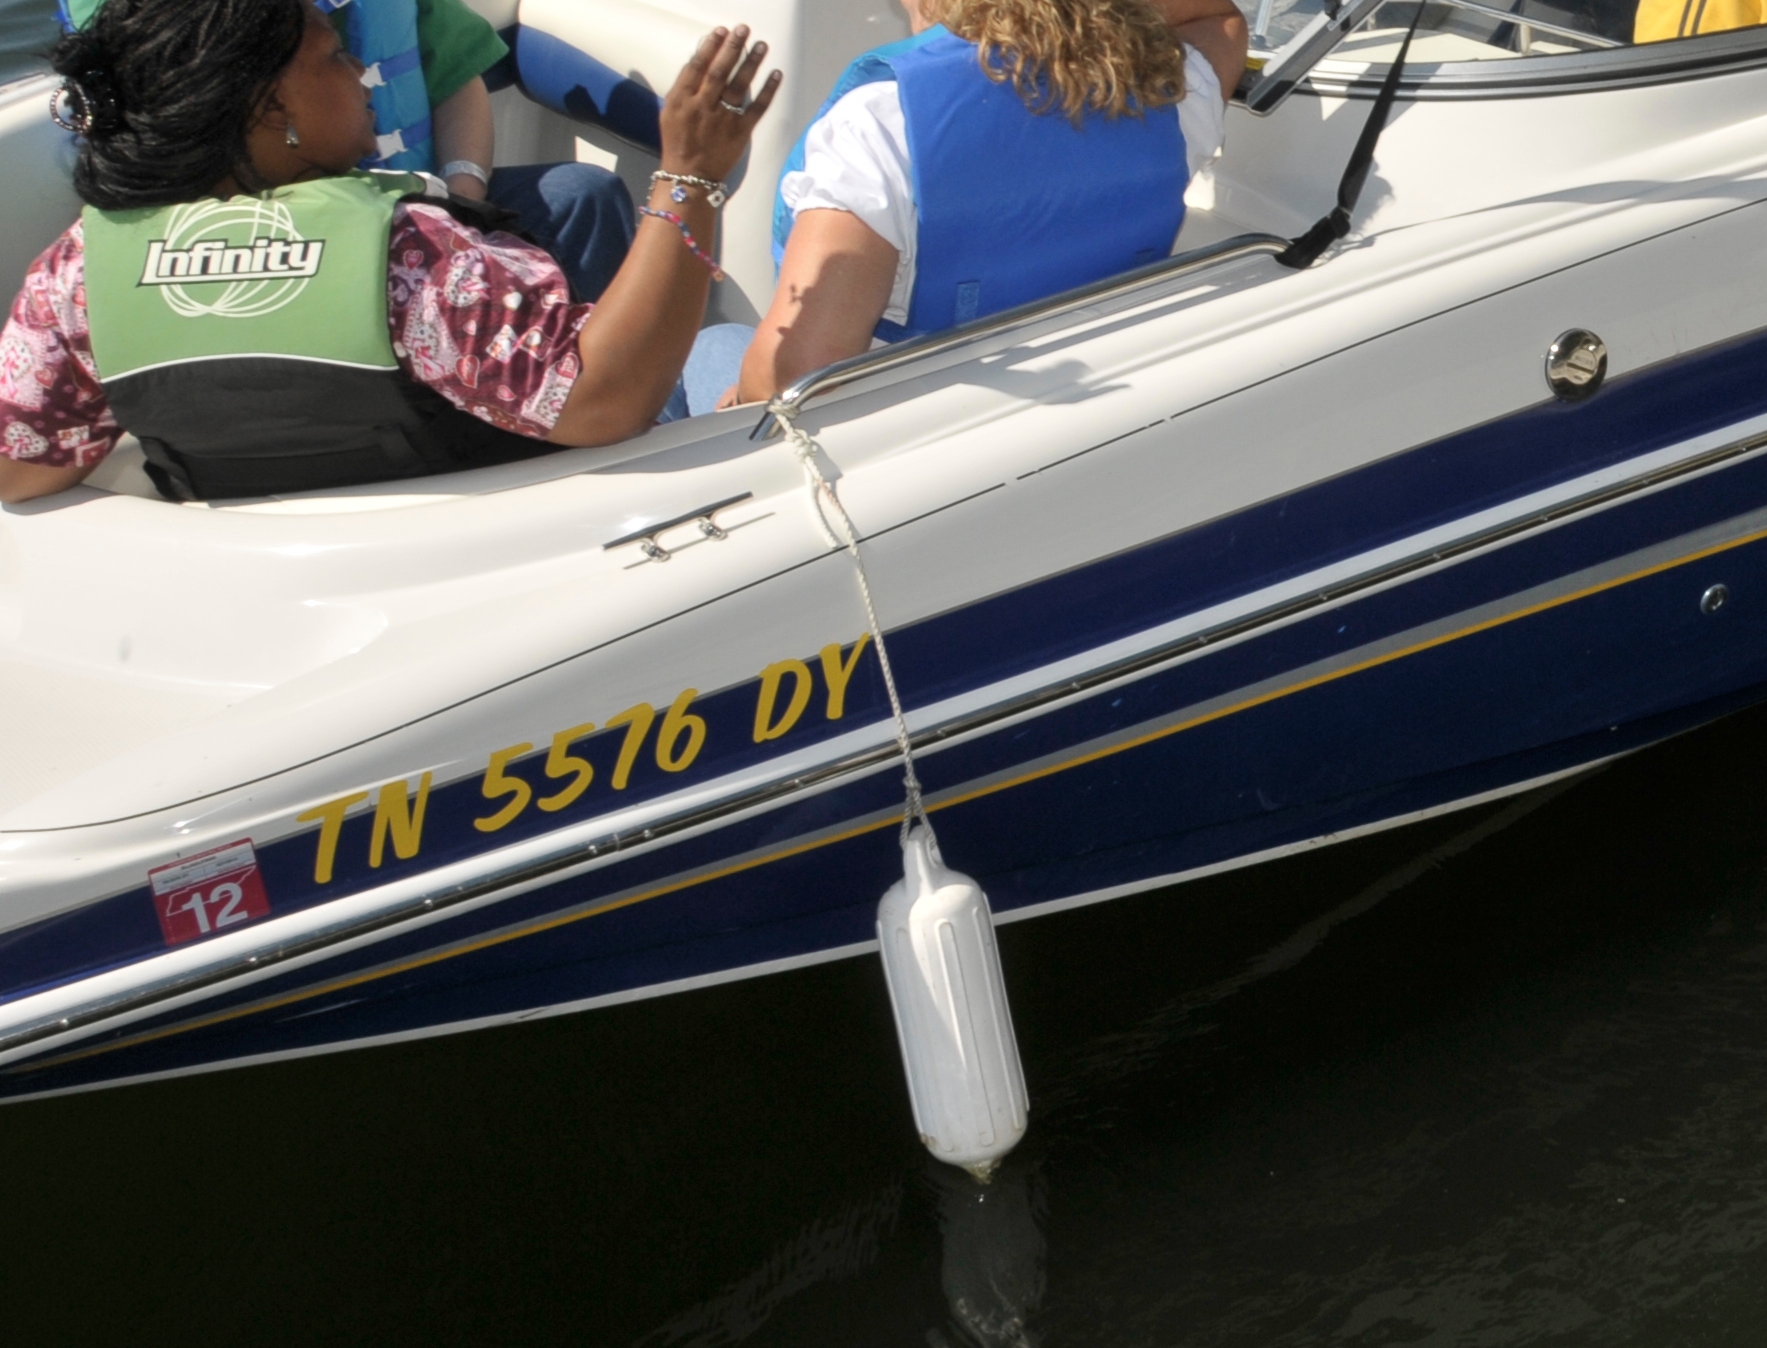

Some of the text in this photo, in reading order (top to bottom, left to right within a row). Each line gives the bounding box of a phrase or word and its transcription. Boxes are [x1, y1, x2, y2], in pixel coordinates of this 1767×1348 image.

[138, 237, 325, 286] Infinity
[296, 632, 869, 884] TN 5576 DY
[181, 882, 249, 933] 12
